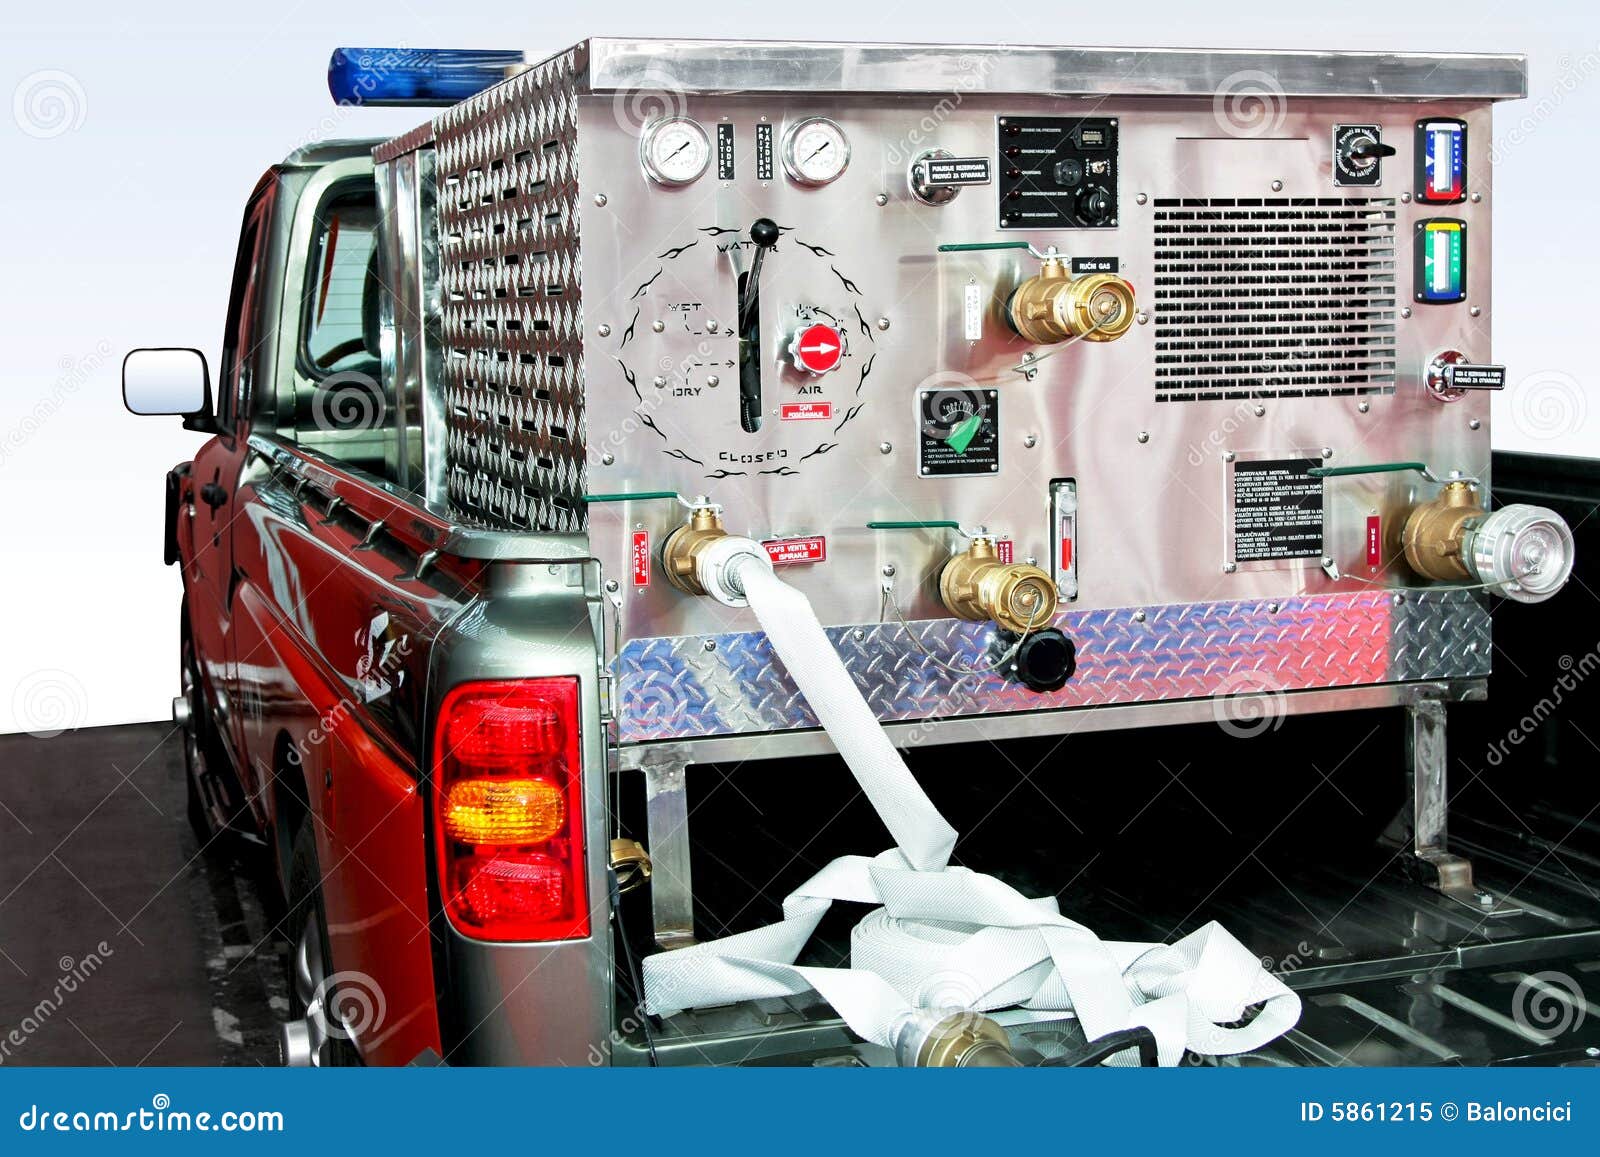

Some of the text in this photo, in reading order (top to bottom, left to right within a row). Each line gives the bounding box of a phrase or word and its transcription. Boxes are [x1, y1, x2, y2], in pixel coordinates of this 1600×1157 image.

[716, 241, 779, 253] WATR
[1098, 262, 1111, 270] GAS
[668, 303, 702, 312] WET
[672, 387, 702, 397] DRY
[798, 386, 823, 395] AIR
[719, 449, 788, 463] CLOSED
[768, 543, 818, 554] CAFS VENTIL ZA
